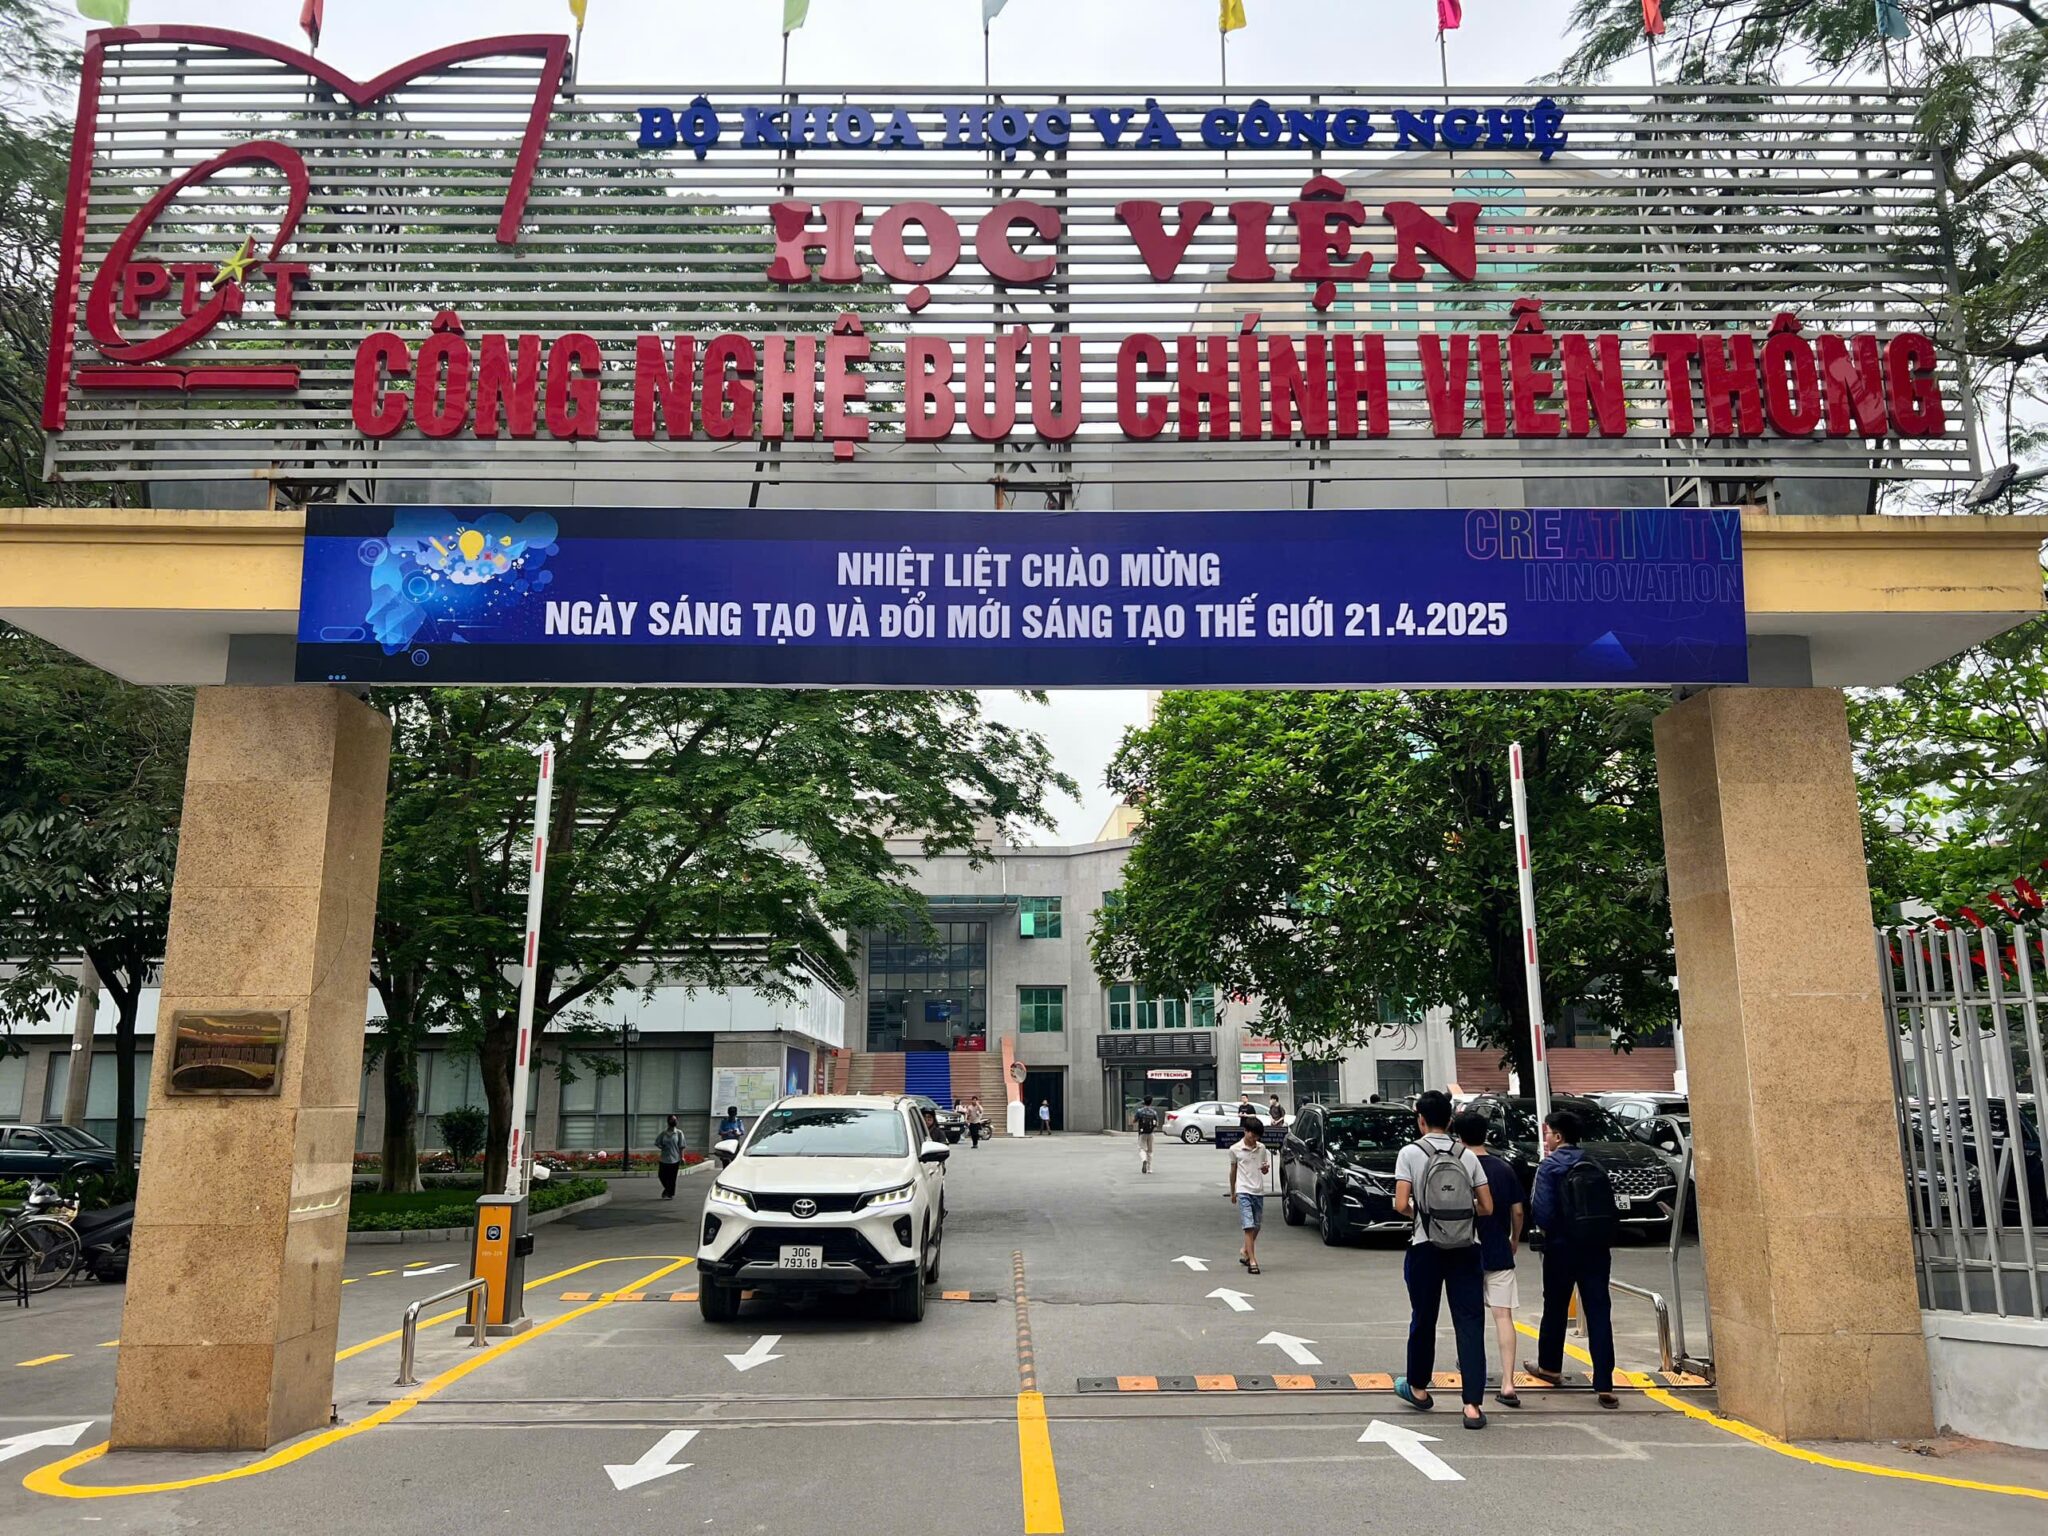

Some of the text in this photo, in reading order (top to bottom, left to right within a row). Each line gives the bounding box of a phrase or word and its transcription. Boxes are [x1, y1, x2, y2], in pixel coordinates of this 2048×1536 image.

[638, 95, 1568, 161] BỘ KHOA HỌC VÀ CÔNG NGHỆ
[767, 175, 1483, 315] HỌC VIỆN
[121, 260, 312, 320] PTIT
[352, 298, 1948, 461] CÔNG NGHỆ BƯU CHÍNH VIỄN THÔNG
[1464, 508, 1740, 561] CREATIVITY
[836, 546, 1222, 595] NHIỆT LIỆT CHÀO MỪNG
[1523, 561, 1742, 603] INNOVATION
[544, 589, 1509, 647] NGÀY SÁNG TẠO VÀ ĐỔI MỚI SÁNG TẠO THẾ GIỚI 21.4.2025
[784, 1257, 818, 1268] 793.18
[791, 1247, 811, 1258] 30G
